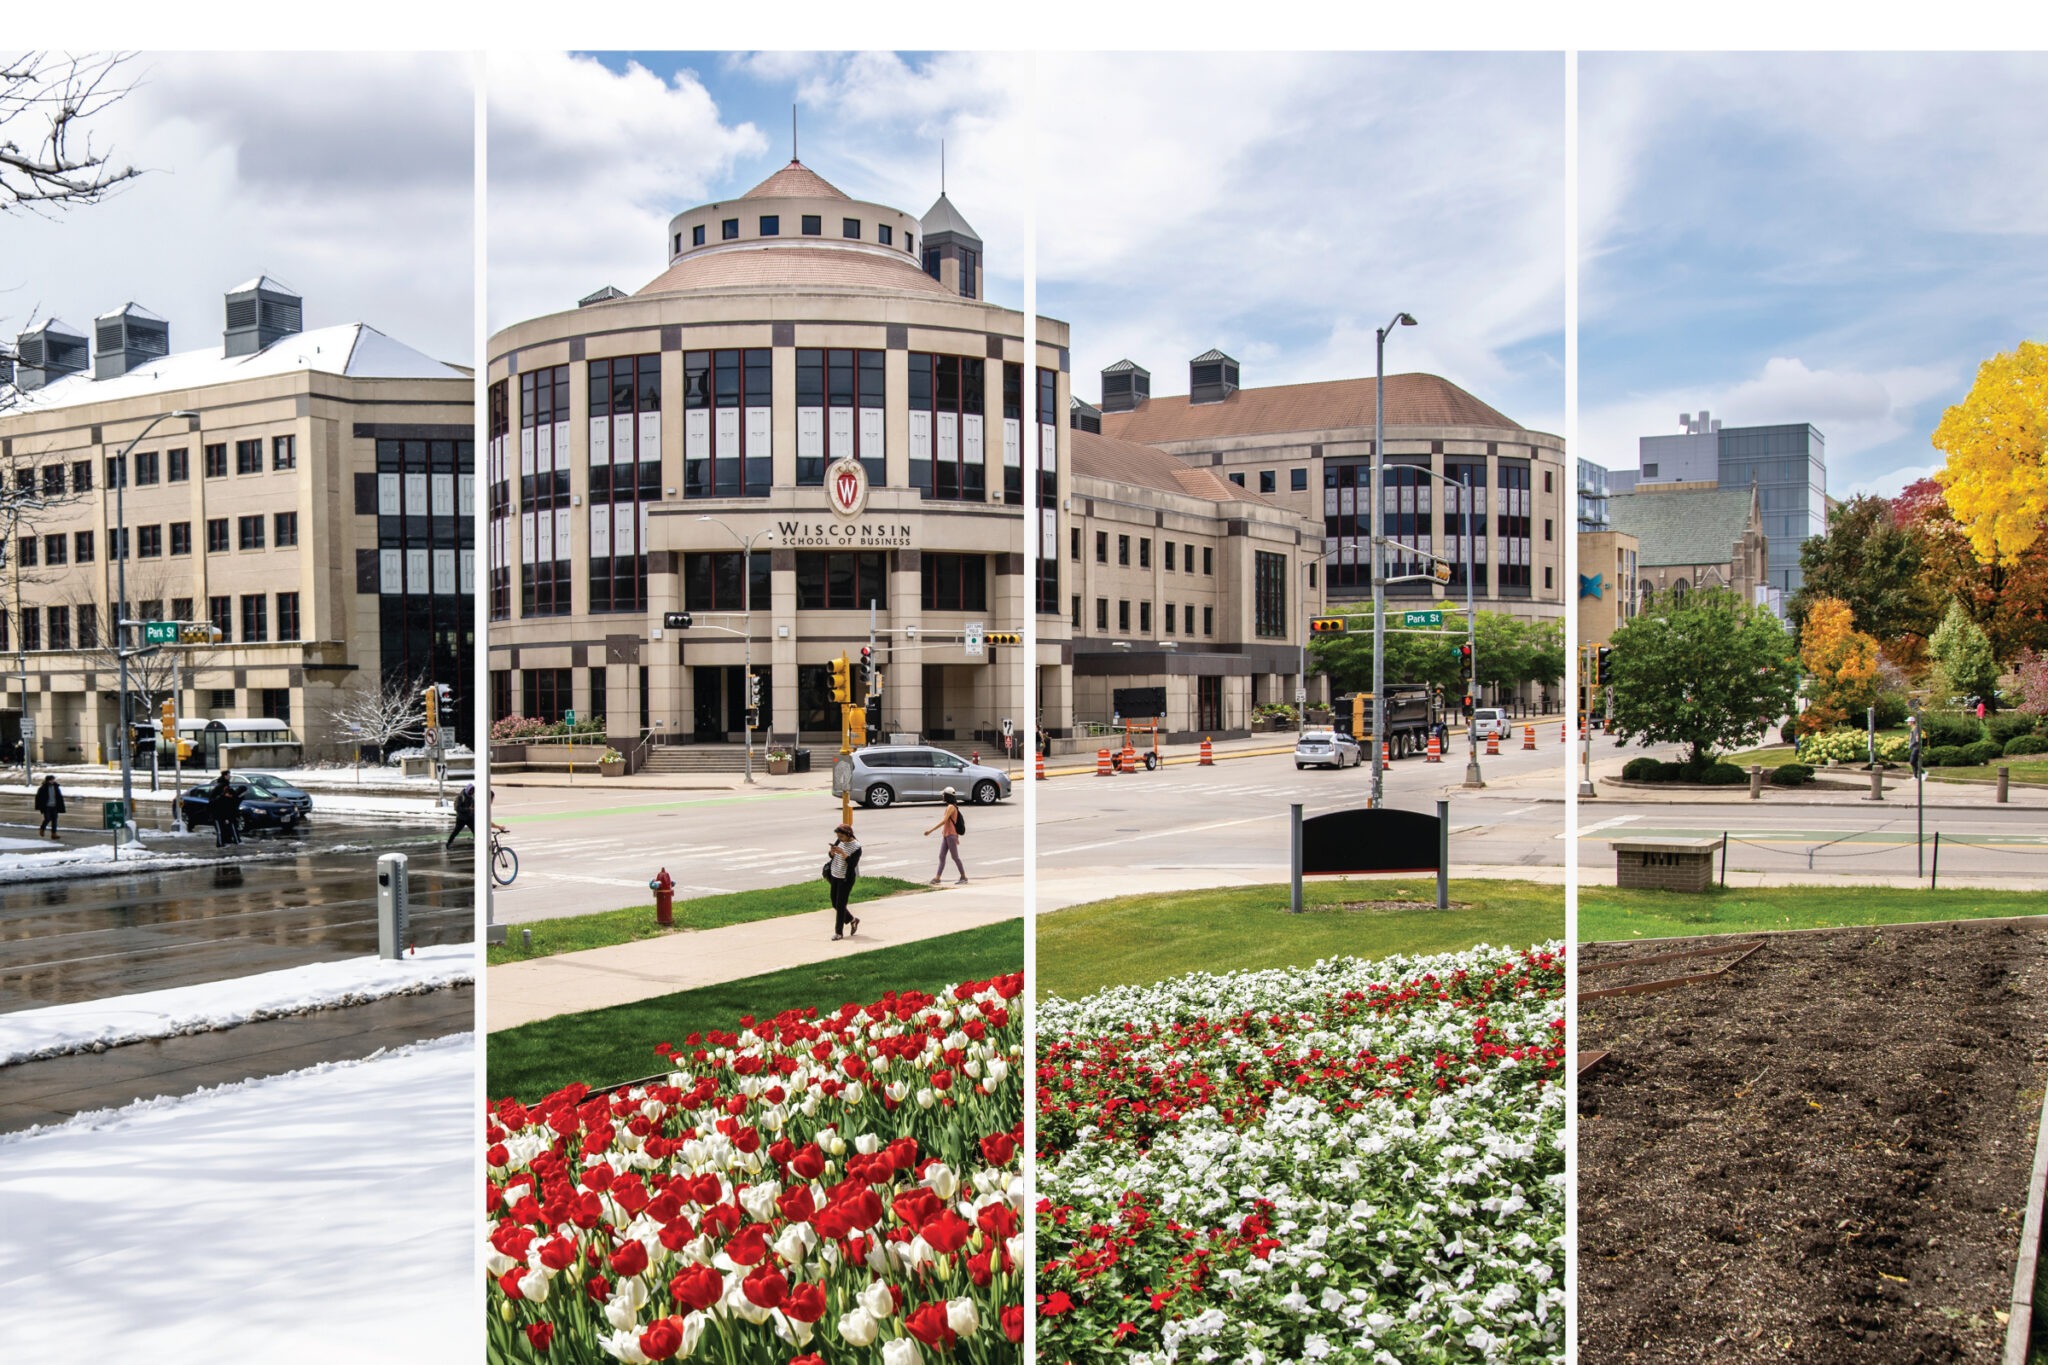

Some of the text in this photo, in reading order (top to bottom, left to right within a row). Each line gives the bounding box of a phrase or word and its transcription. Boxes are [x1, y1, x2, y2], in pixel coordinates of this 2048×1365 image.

[838, 479, 855, 504] W
[778, 522, 911, 537] WISCONSIN
[782, 537, 911, 546] SCHOOL OF BUSINESS
[1407, 613, 1440, 624] Park St
[147, 627, 175, 638] Park St
